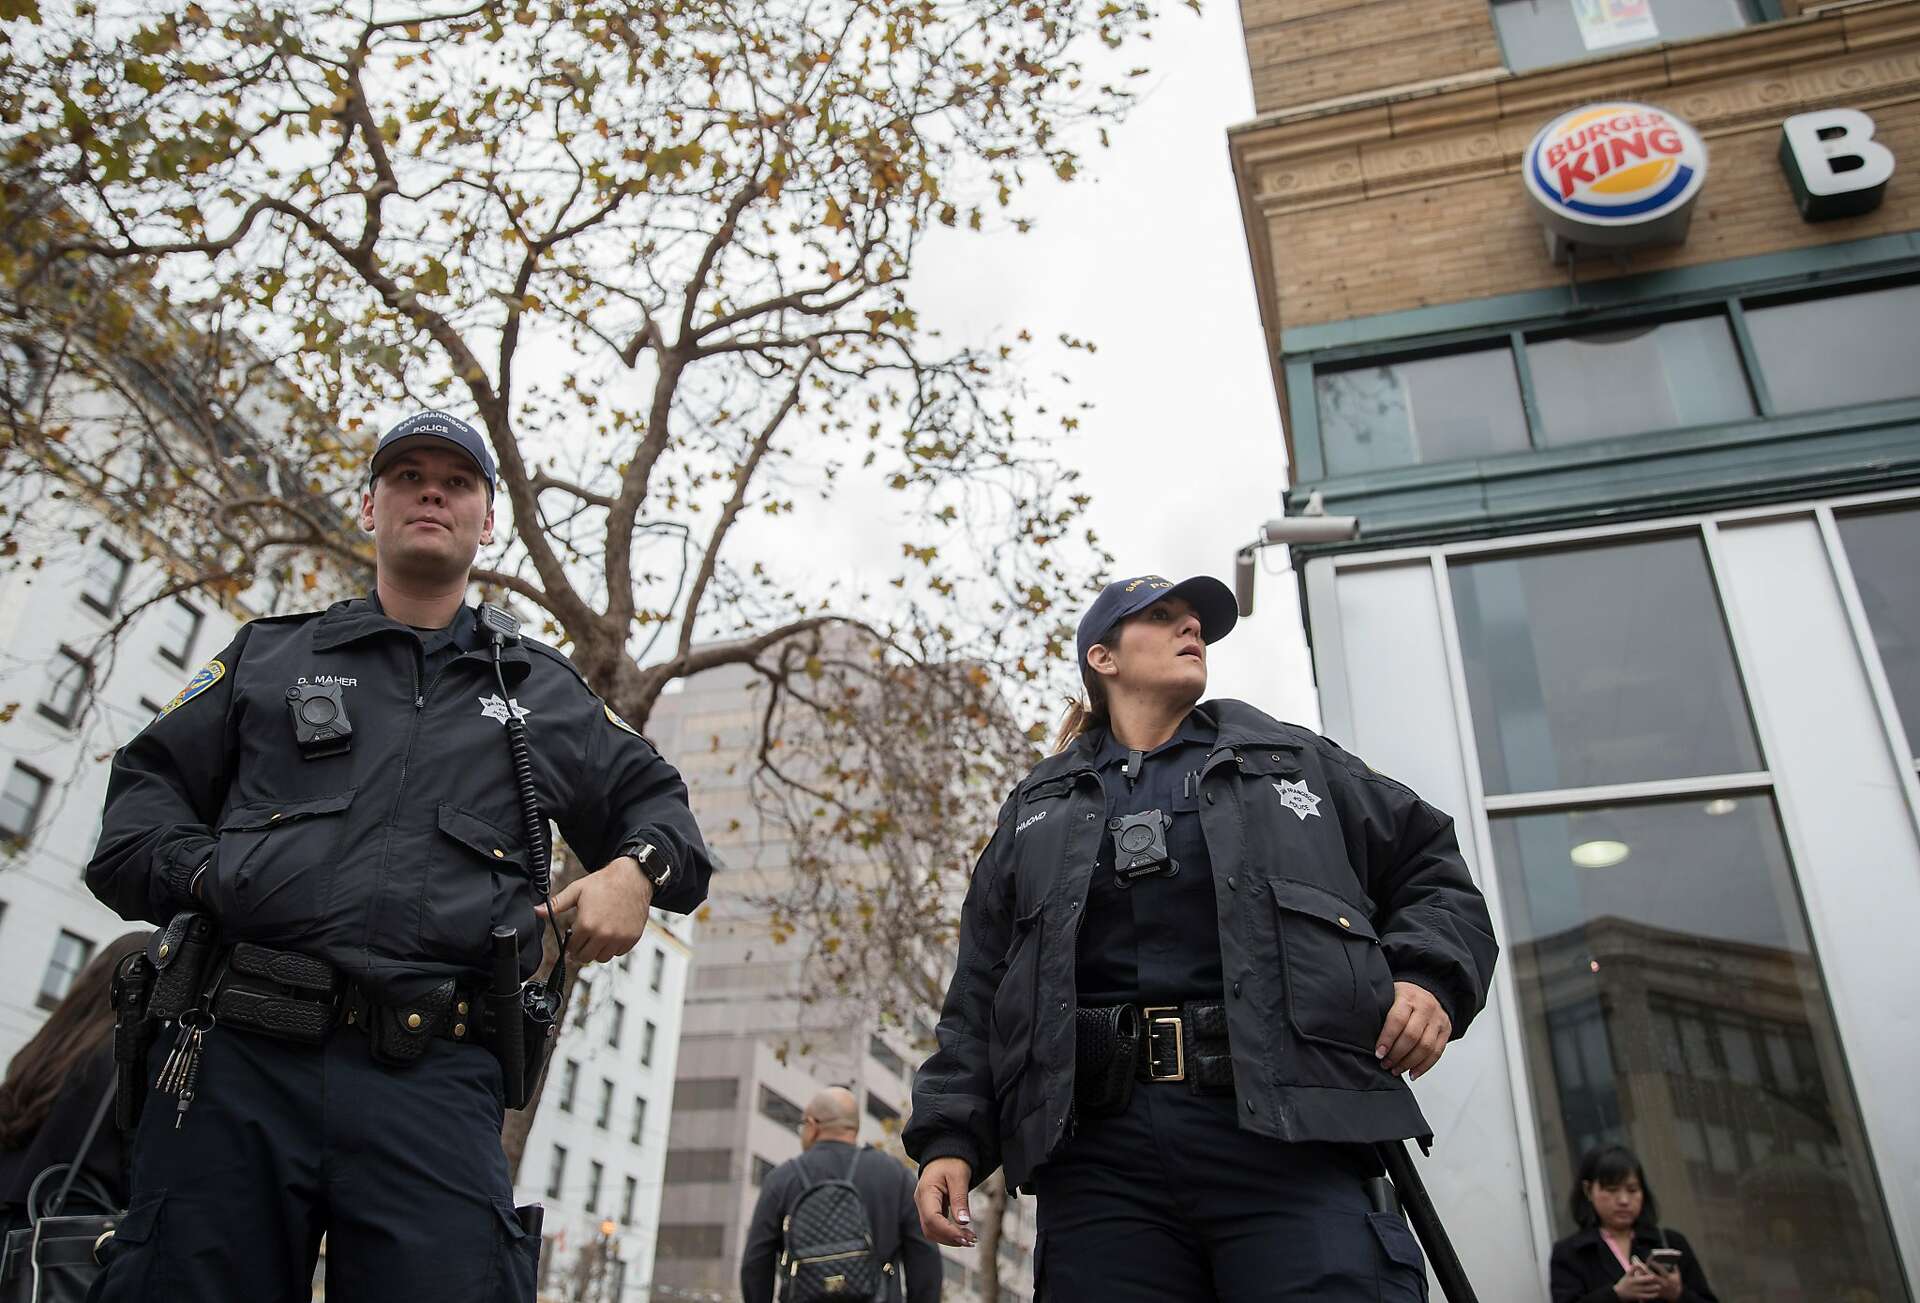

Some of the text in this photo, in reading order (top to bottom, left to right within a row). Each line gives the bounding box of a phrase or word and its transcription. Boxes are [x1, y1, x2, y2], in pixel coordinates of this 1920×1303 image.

[1546, 112, 1664, 169] BURGER
[1783, 108, 1895, 196] B
[1558, 128, 1683, 199] KING
[398, 412, 469, 433] SAN FRANCISCO
[413, 424, 449, 434] POLICE
[314, 675, 358, 687] MAHER
